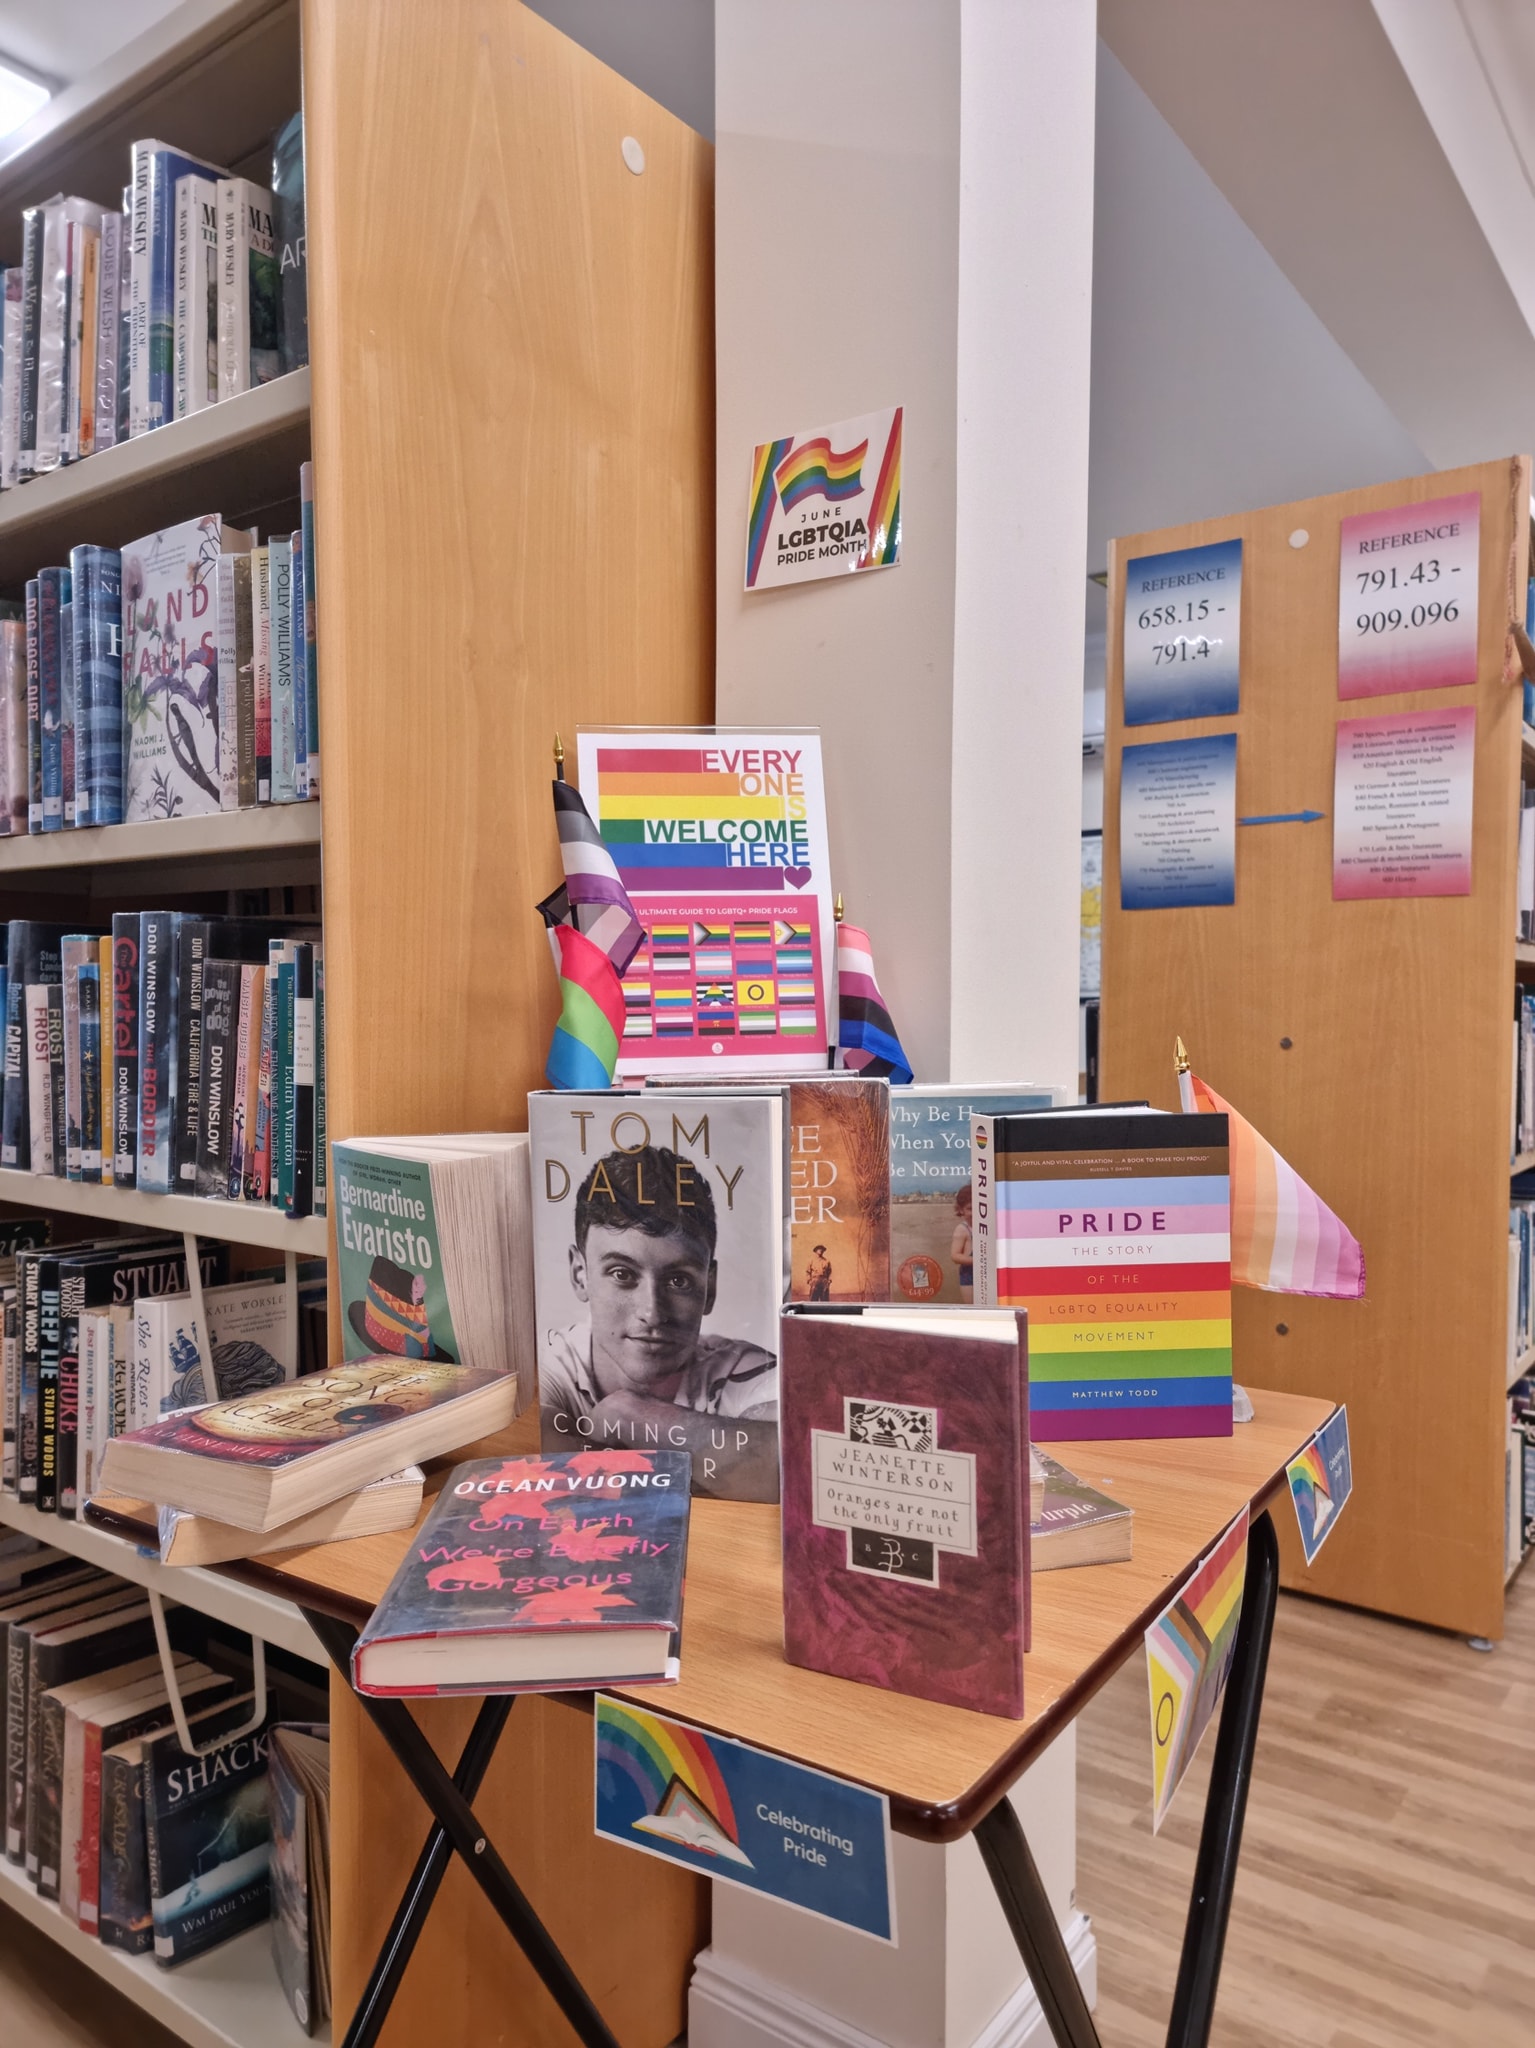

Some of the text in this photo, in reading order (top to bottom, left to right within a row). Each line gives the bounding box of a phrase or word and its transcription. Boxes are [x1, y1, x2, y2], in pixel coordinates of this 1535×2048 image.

[135, 150, 149, 257] MARY WESLEY
[179, 210, 188, 241] MARY
[225, 212, 235, 287] MARY WESLEY
[102, 225, 116, 338] LOUISE WELSH
[179, 245, 187, 292] WESLEY
[801, 507, 841, 523] JUNE
[777, 539, 867, 566] PRIDE MONTH
[778, 518, 867, 550] LGBTQIA
[1359, 523, 1460, 555] REFERENCE
[258, 556, 270, 615] Husband,
[1141, 567, 1225, 593] REFERENCE
[1356, 560, 1441, 595] 791.43
[127, 584, 209, 636] LAND
[278, 564, 291, 687] POLLY WILLIAMS
[1138, 600, 1210, 630] 658.15
[1356, 599, 1459, 636] 909.096
[27, 598, 39, 720] DOG ROSE DIRT
[123, 631, 214, 684] FALLS
[1152, 640, 1211, 666] 791.4
[258, 664, 267, 710] WILLIAMS
[240, 680, 255, 764] polly williams
[133, 746, 167, 760] WILLIAMS
[134, 735, 157, 747] NAOMI
[702, 750, 802, 773] EVERY
[740, 773, 805, 796] ONE
[646, 819, 809, 843] WELCOME
[727, 842, 811, 866] HERE
[639, 908, 677, 916] ULTIMATE
[749, 907, 772, 915] PRIDE
[146, 924, 157, 955] DON
[191, 938, 203, 959] DON
[114, 936, 138, 1056] Cartel
[145, 960, 157, 1034] WINSLOW
[190, 963, 202, 1012] WINSLOW
[241, 978, 251, 1018] MAISIE
[188, 1019, 201, 1078] CALIFORNIA
[34, 1008, 49, 1063] FROST
[43, 1093, 52, 1143] WINGFIELD
[49, 1008, 63, 1064] FROST
[59, 1095, 67, 1146] WINGFIELD
[187, 1082, 199, 1104] FIRE
[284, 1065, 295, 1103] Edith
[118, 1067, 129, 1157] DON WINSLOW
[142, 1068, 157, 1157] BORDER
[207, 1046, 222, 1154] DON WINSLOW
[928, 1106, 950, 1121] Be
[186, 1116, 198, 1137] LIFE
[284, 1109, 294, 1166] Wharton
[570, 1111, 711, 1158] TOM
[317, 1133, 325, 1182] Wharton
[1020, 1160, 1041, 1168] JOYFUL
[340, 1175, 426, 1221] Bernardine
[545, 1160, 744, 1210] DALEY
[977, 1158, 988, 1236] PRIDE
[341, 1205, 433, 1270] Evaristo
[1058, 1211, 1166, 1233] PRIDE
[1072, 1245, 1153, 1256] THE STORY
[61, 1278, 72, 1318] WOODS
[71, 1276, 85, 1318] STUART
[1087, 1274, 1140, 1285] OF THE
[25, 1262, 38, 1353] STUART WOODS
[206, 1304, 235, 1317] KATE
[1049, 1301, 1179, 1316] LGBTQ EQUALITY
[1073, 1331, 1156, 1343] MOVEMENT
[138, 1316, 152, 1408] She Rises
[40, 1290, 59, 1477] DEEP LIE STUART WOODS
[61, 1357, 78, 1434] CHOKE
[1072, 1388, 1158, 1398] MATTHEW TODD
[553, 1413, 748, 1451] COMING UP
[226, 1443, 294, 1464] MILLER
[839, 1448, 946, 1476] JEANETTE
[453, 1473, 671, 1495] OCEAN VUONG
[832, 1461, 954, 1493] WINTERSON
[468, 1512, 633, 1532] On Earth
[827, 1488, 959, 1522] Oranges are not
[833, 1504, 953, 1538] the only fruit
[419, 1539, 670, 1563] We're Briefly
[434, 1571, 632, 1593] Gorgeous
[167, 1733, 270, 1803] SHACK
[756, 1803, 854, 1856] Celebrating
[783, 1837, 828, 1868] Pride
[148, 1848, 160, 1898] SHACK
